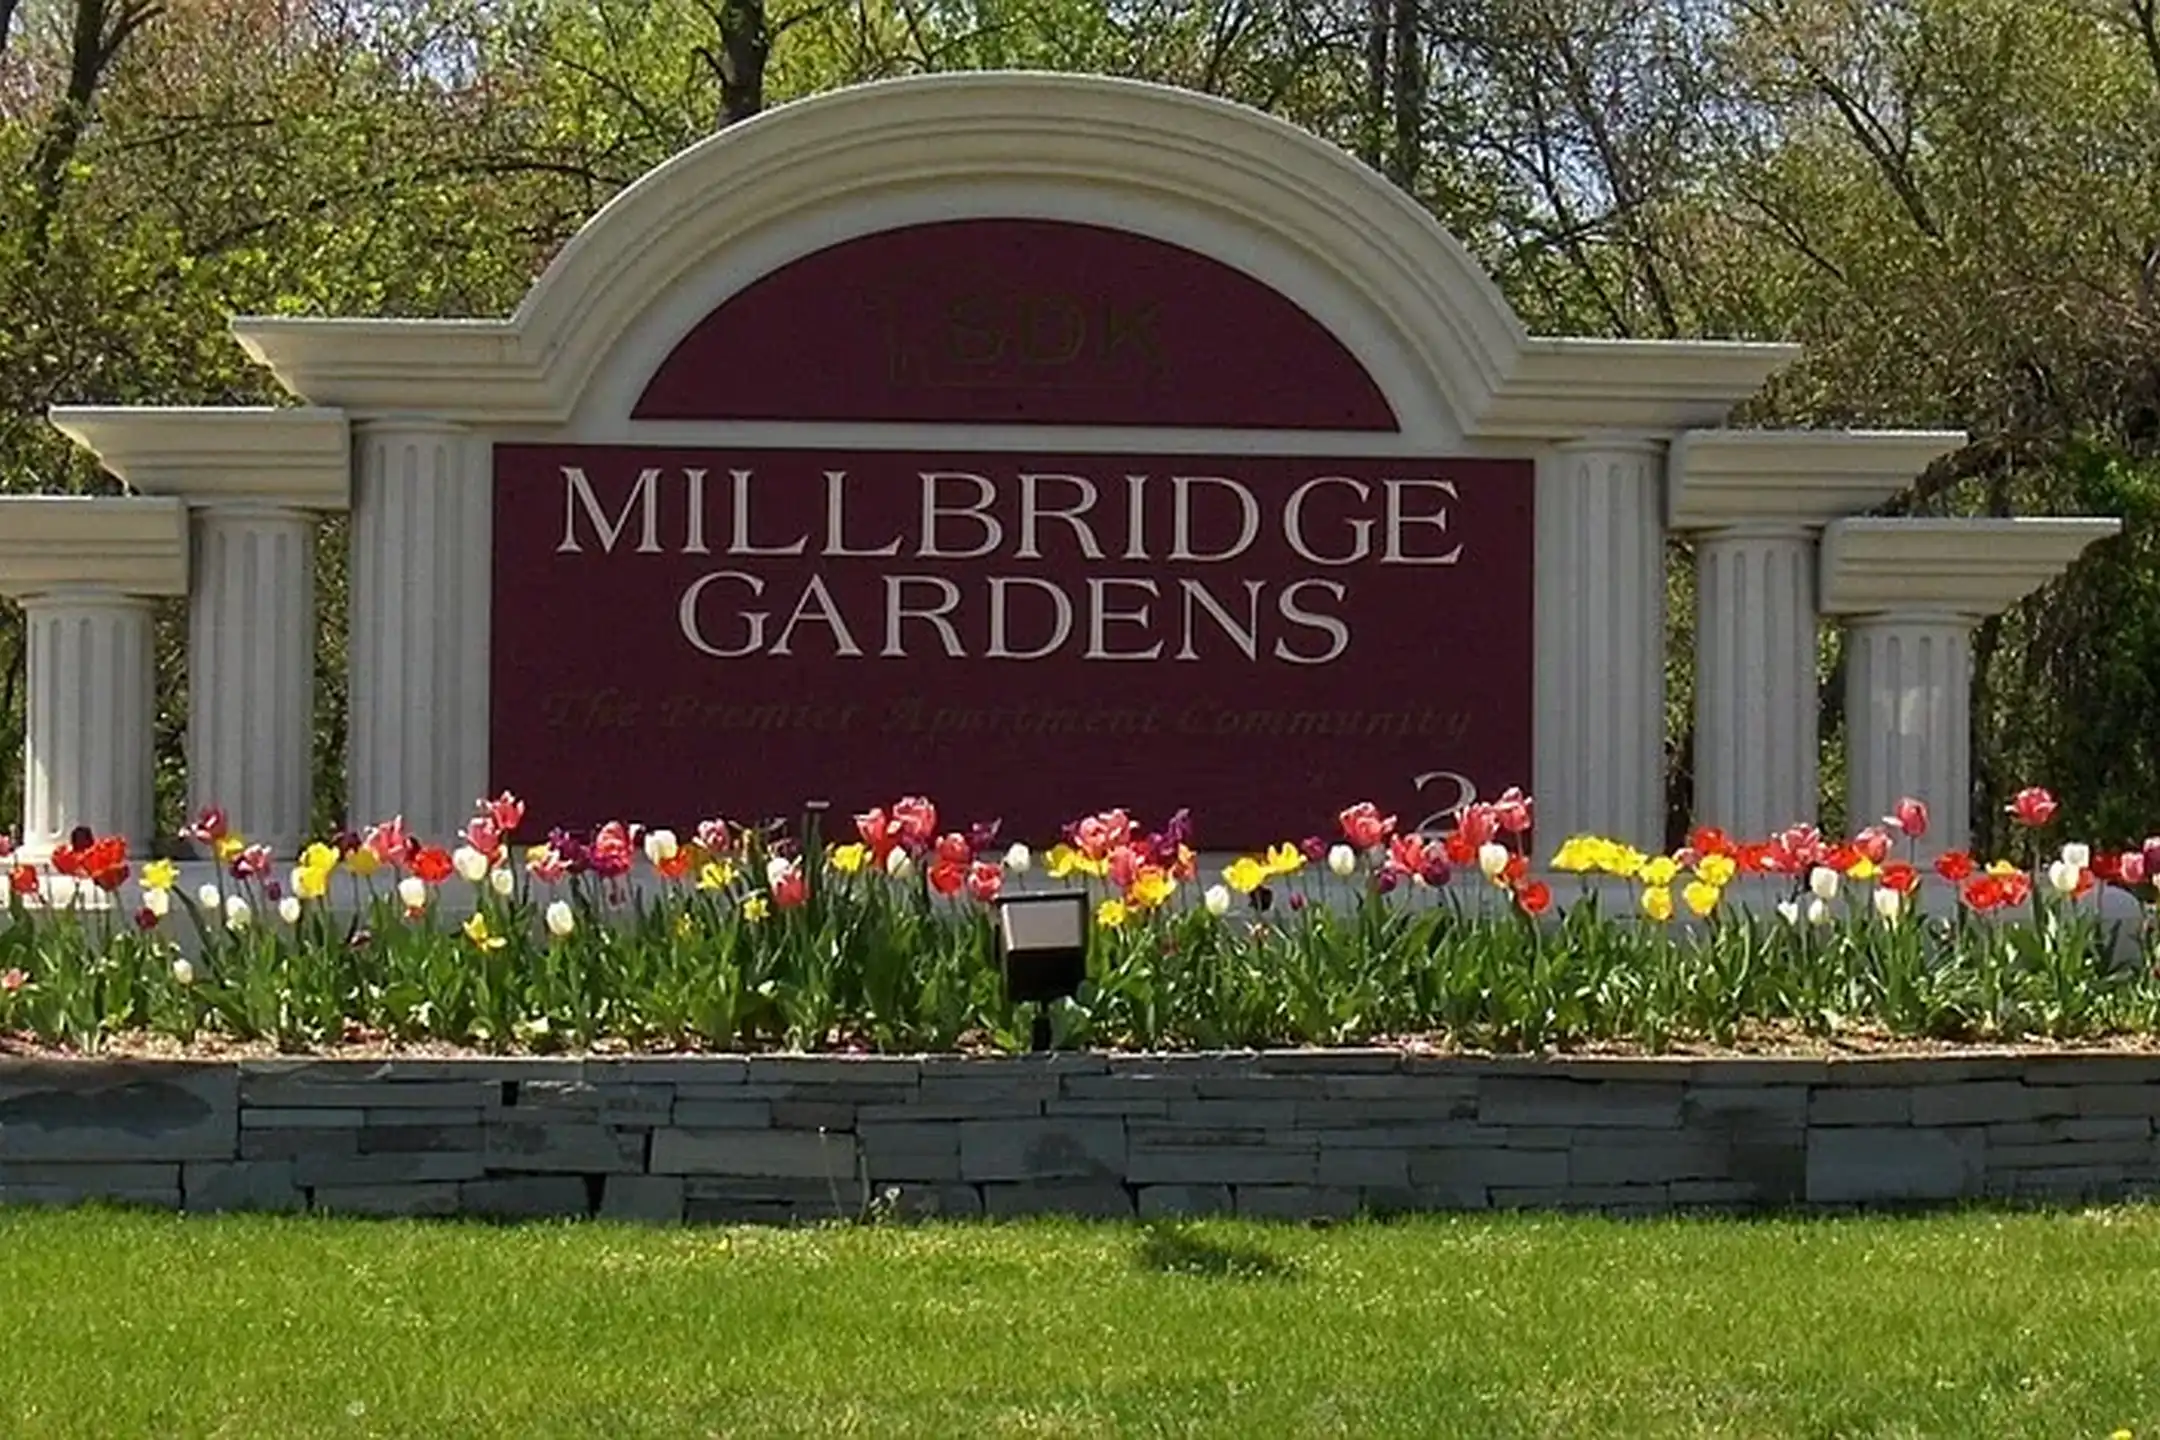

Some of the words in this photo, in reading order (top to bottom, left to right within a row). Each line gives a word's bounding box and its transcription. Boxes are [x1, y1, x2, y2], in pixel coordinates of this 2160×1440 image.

[557, 467, 1463, 566] MILLBRIDGE
[679, 571, 1350, 664] GARDENS
[544, 691, 640, 729] The
[660, 692, 866, 729] Premier
[881, 690, 1164, 740] Apartment
[1175, 692, 1473, 741] Community
